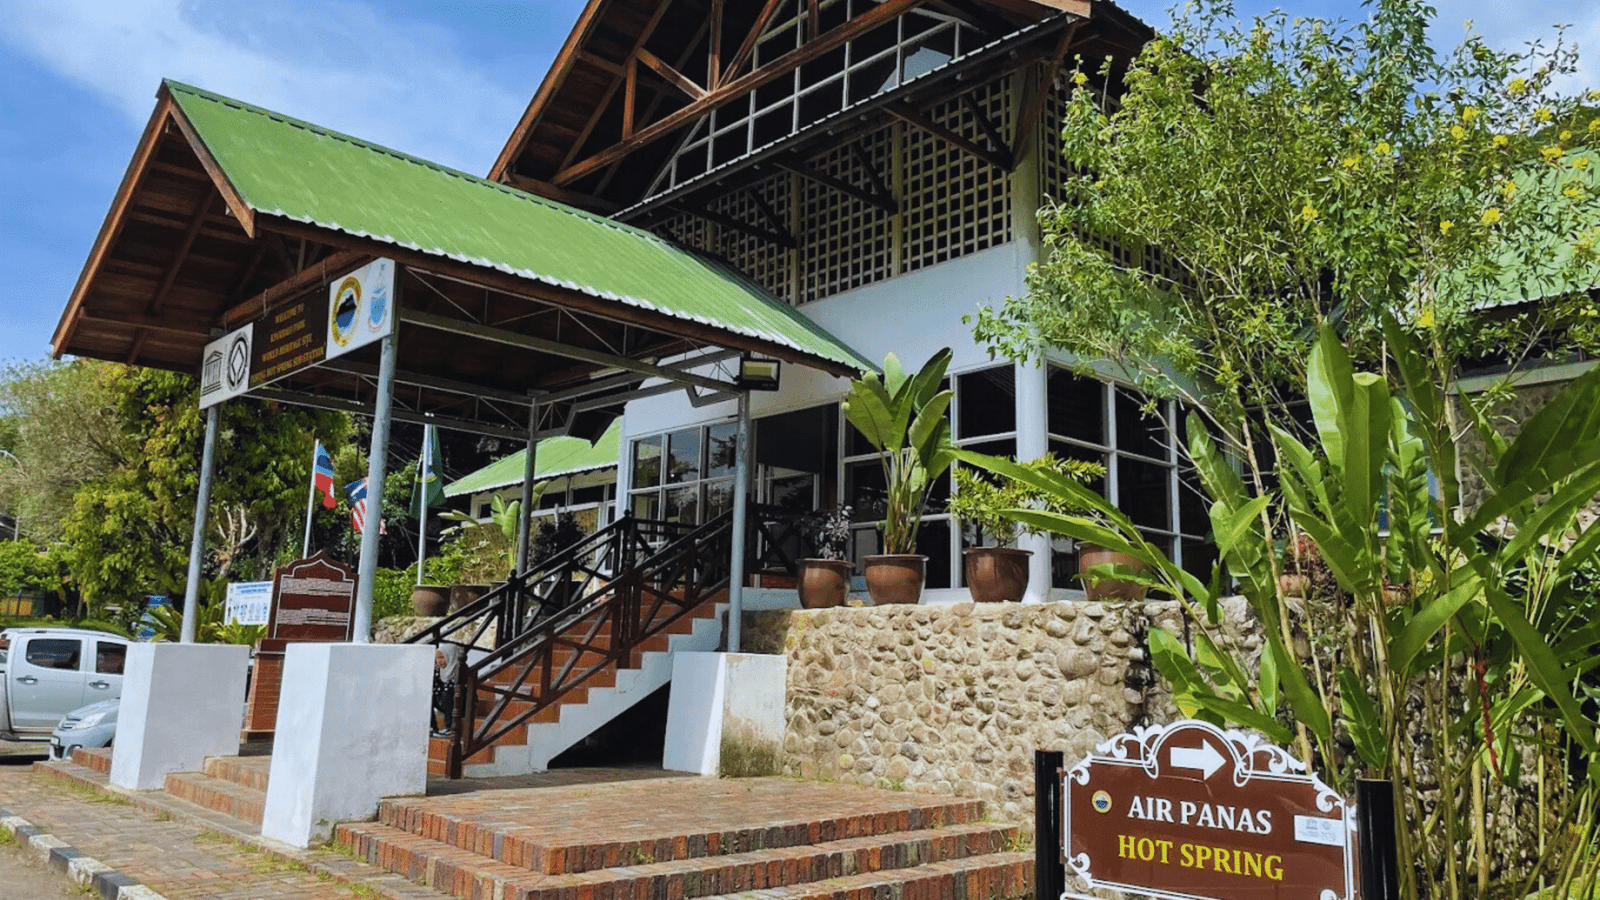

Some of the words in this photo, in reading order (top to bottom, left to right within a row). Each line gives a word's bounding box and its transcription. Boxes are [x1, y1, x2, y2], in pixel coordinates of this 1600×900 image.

[1127, 795, 1174, 823] AIR
[1180, 801, 1272, 835] PANAS
[1118, 835, 1173, 864] HOT
[1180, 843, 1283, 881] SPRING
